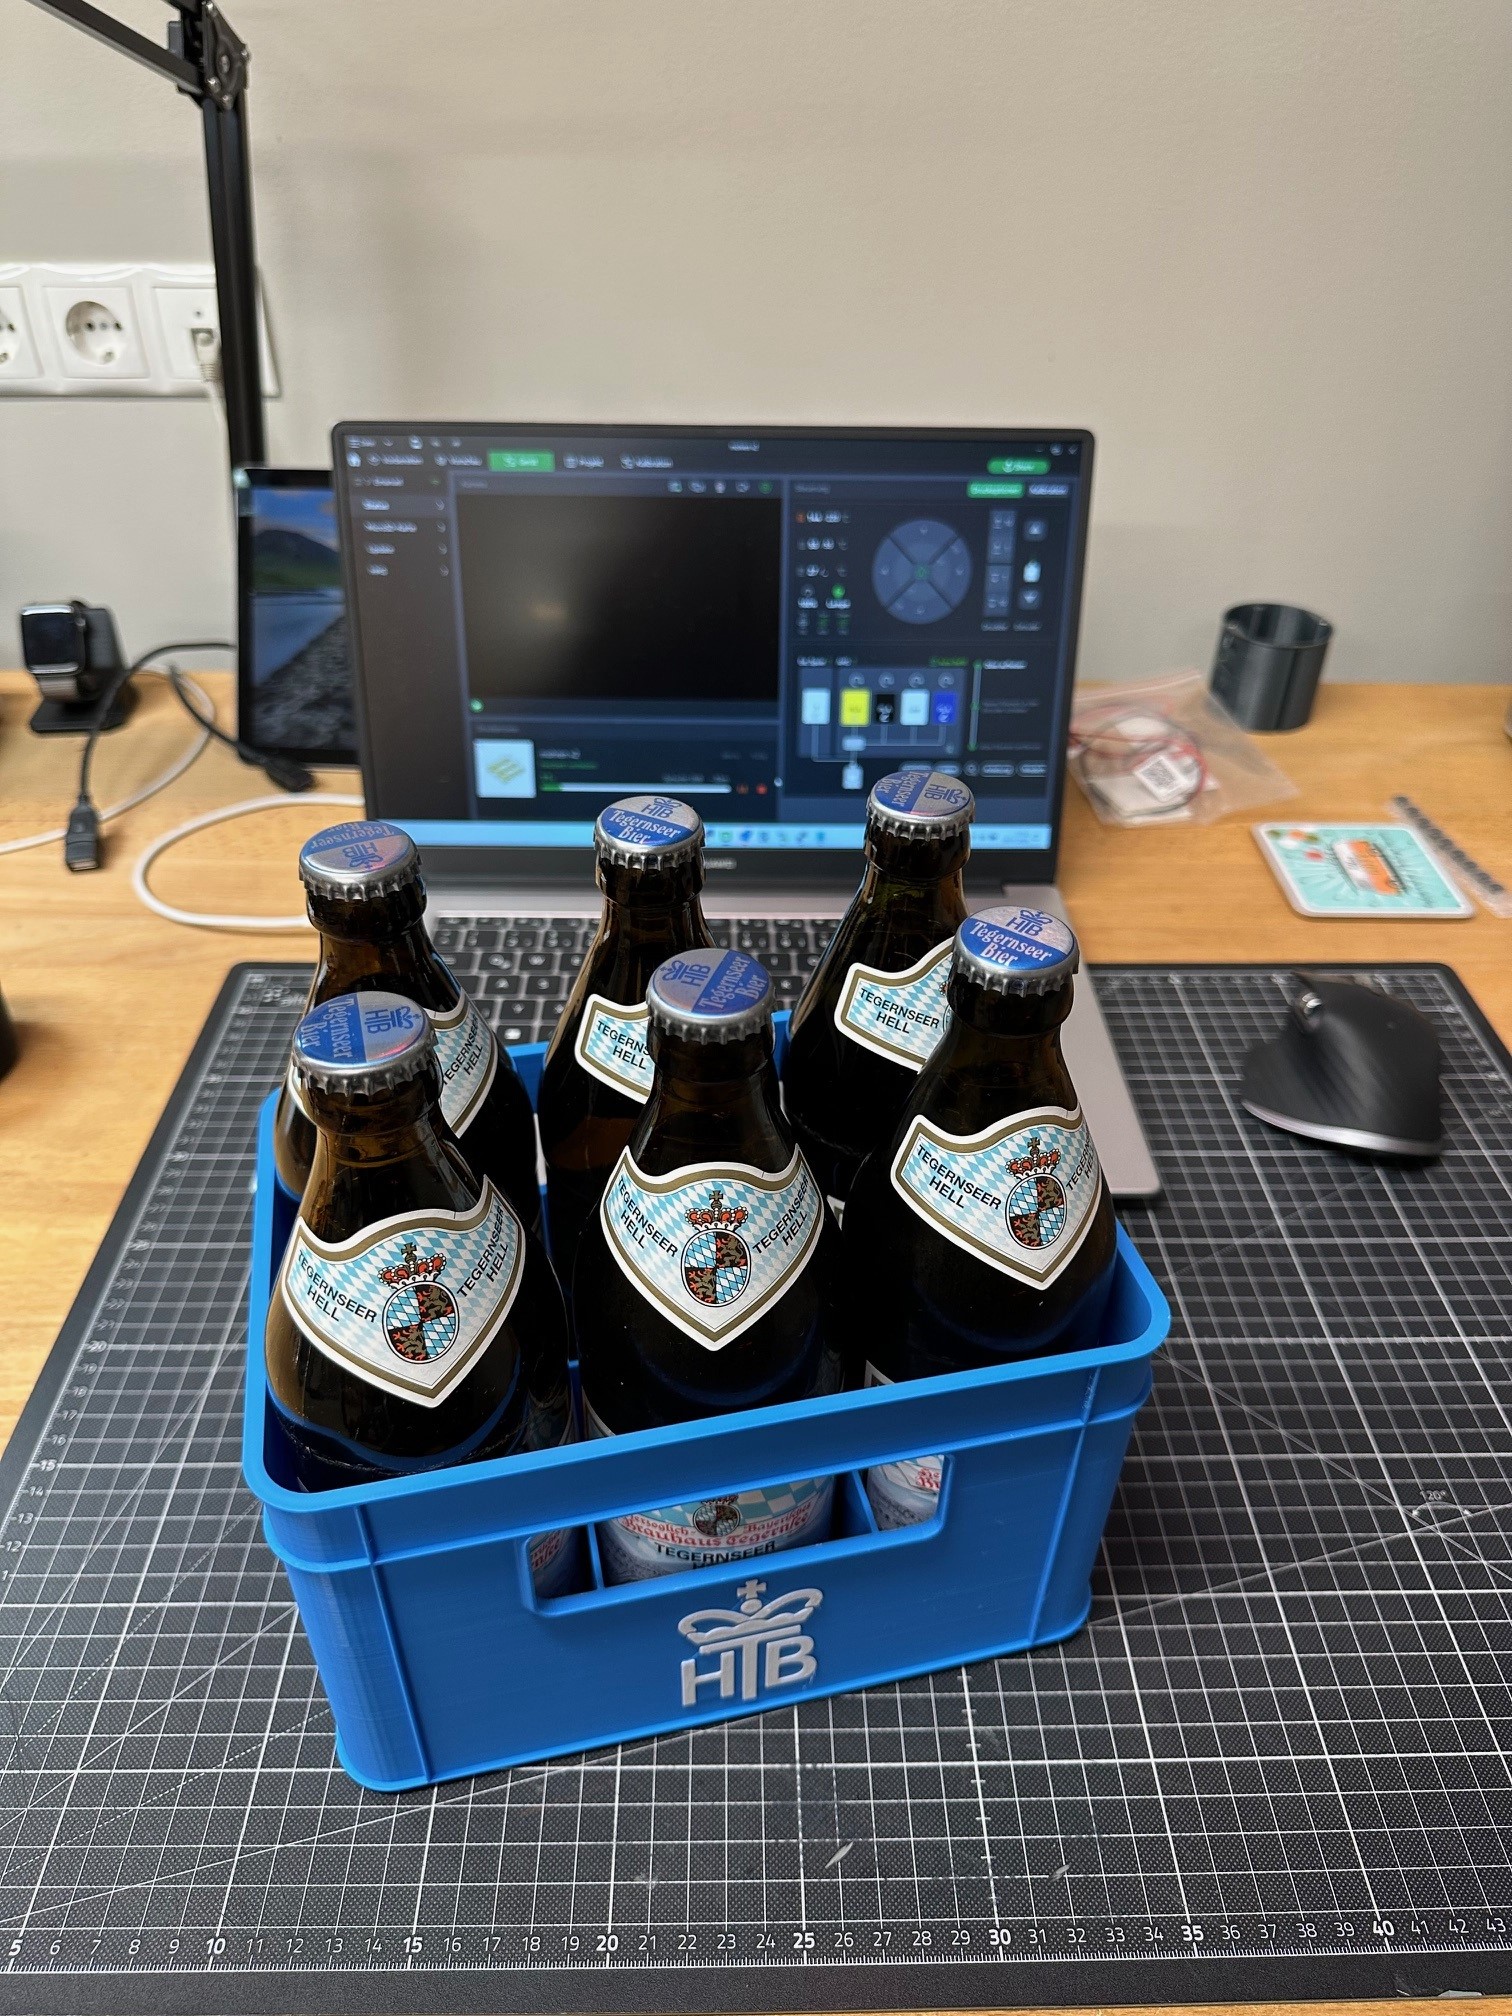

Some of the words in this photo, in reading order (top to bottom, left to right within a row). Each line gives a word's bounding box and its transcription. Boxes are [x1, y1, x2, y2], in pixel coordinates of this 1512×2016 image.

[875, 778, 899, 795] Bier
[891, 771, 929, 807] Tegernseer
[609, 809, 682, 839] Tegernseer
[641, 803, 674, 819] HTB
[618, 825, 652, 845] Bier
[969, 921, 1053, 962] Tegernseer
[1005, 916, 1043, 937] HTB
[980, 942, 1019, 967] Bier
[698, 956, 751, 1010] Tegernseer
[734, 974, 768, 1001] Bier
[859, 987, 940, 1029] TEGERNSEER
[876, 1010, 910, 1034] HELL
[300, 1023, 328, 1049] Bier
[322, 997, 354, 1059] Tegernseer
[597, 1019, 650, 1057] TEGERNS
[463, 1043, 484, 1076] HELL
[612, 1045, 647, 1071] HELL
[917, 1144, 1002, 1211] TEGERNSEER
[928, 1174, 965, 1210] HELL
[617, 1177, 679, 1258] TEGERNSEER
[620, 1208, 647, 1249] HELL
[752, 1173, 809, 1255] TEGERNSEER
[782, 1210, 808, 1247] HELL
[456, 1204, 504, 1298] TEGERNSEER
[486, 1243, 508, 1283] HELL
[297, 1249, 378, 1324] TEGERNSEER
[306, 1285, 340, 1322] HELL
[61, 1409, 78, 1421] 17
[51, 1433, 67, 1446] 16
[40, 1459, 57, 1472] 15
[29, 1485, 44, 1498] 14
[18, 1512, 34, 1525] 13
[621, 1516, 721, 1547] Brauhaus
[4, 1540, 22, 1553] 12
[654, 1541, 776, 1565] TEGERNSEER
[680, 1623, 818, 1707] HTB
[8, 1938, 24, 1957] 5
[49, 1939, 63, 1956] 6
[90, 1939, 102, 1955] 7
[128, 1938, 141, 1955] 8
[168, 1938, 180, 1955] 9
[206, 1937, 226, 1955] 10
[246, 1938, 264, 1954] 11
[286, 1938, 304, 1954] 12
[325, 1937, 344, 1953] 13
[364, 1937, 383, 1953] 14
[403, 1936, 423, 1954] 15
[443, 1937, 462, 1952] 16
[482, 1936, 502, 1952] 17
[522, 1936, 541, 1952] 18
[561, 1935, 580, 1951] 19
[595, 1934, 619, 1952] 20
[638, 1934, 656, 1951] 21
[677, 1934, 697, 1950] 22
[716, 1933, 736, 1950] 23
[756, 1933, 776, 1949] 24
[793, 1931, 815, 1949] 25
[834, 1931, 854, 1948] 26
[872, 1931, 892, 1947] 27
[911, 1930, 932, 1946] 28
[950, 1929, 971, 1946] 29
[988, 1928, 1012, 1946] 30
[1027, 1928, 1047, 1944] 31
[1066, 1927, 1087, 1943] 32
[1106, 1926, 1126, 1943] 33
[1143, 1926, 1164, 1942] 34
[1180, 1924, 1204, 1942] 35
[1219, 1924, 1241, 1940] 36
[1257, 1923, 1277, 1939] 37
[1295, 1922, 1318, 1938] 38
[1333, 1921, 1355, 1937] 39
[1372, 1920, 1395, 1937] 40
[1411, 1920, 1430, 1935] 41
[1449, 1918, 1470, 1934] 42
[1486, 1917, 1506, 1933] 43
